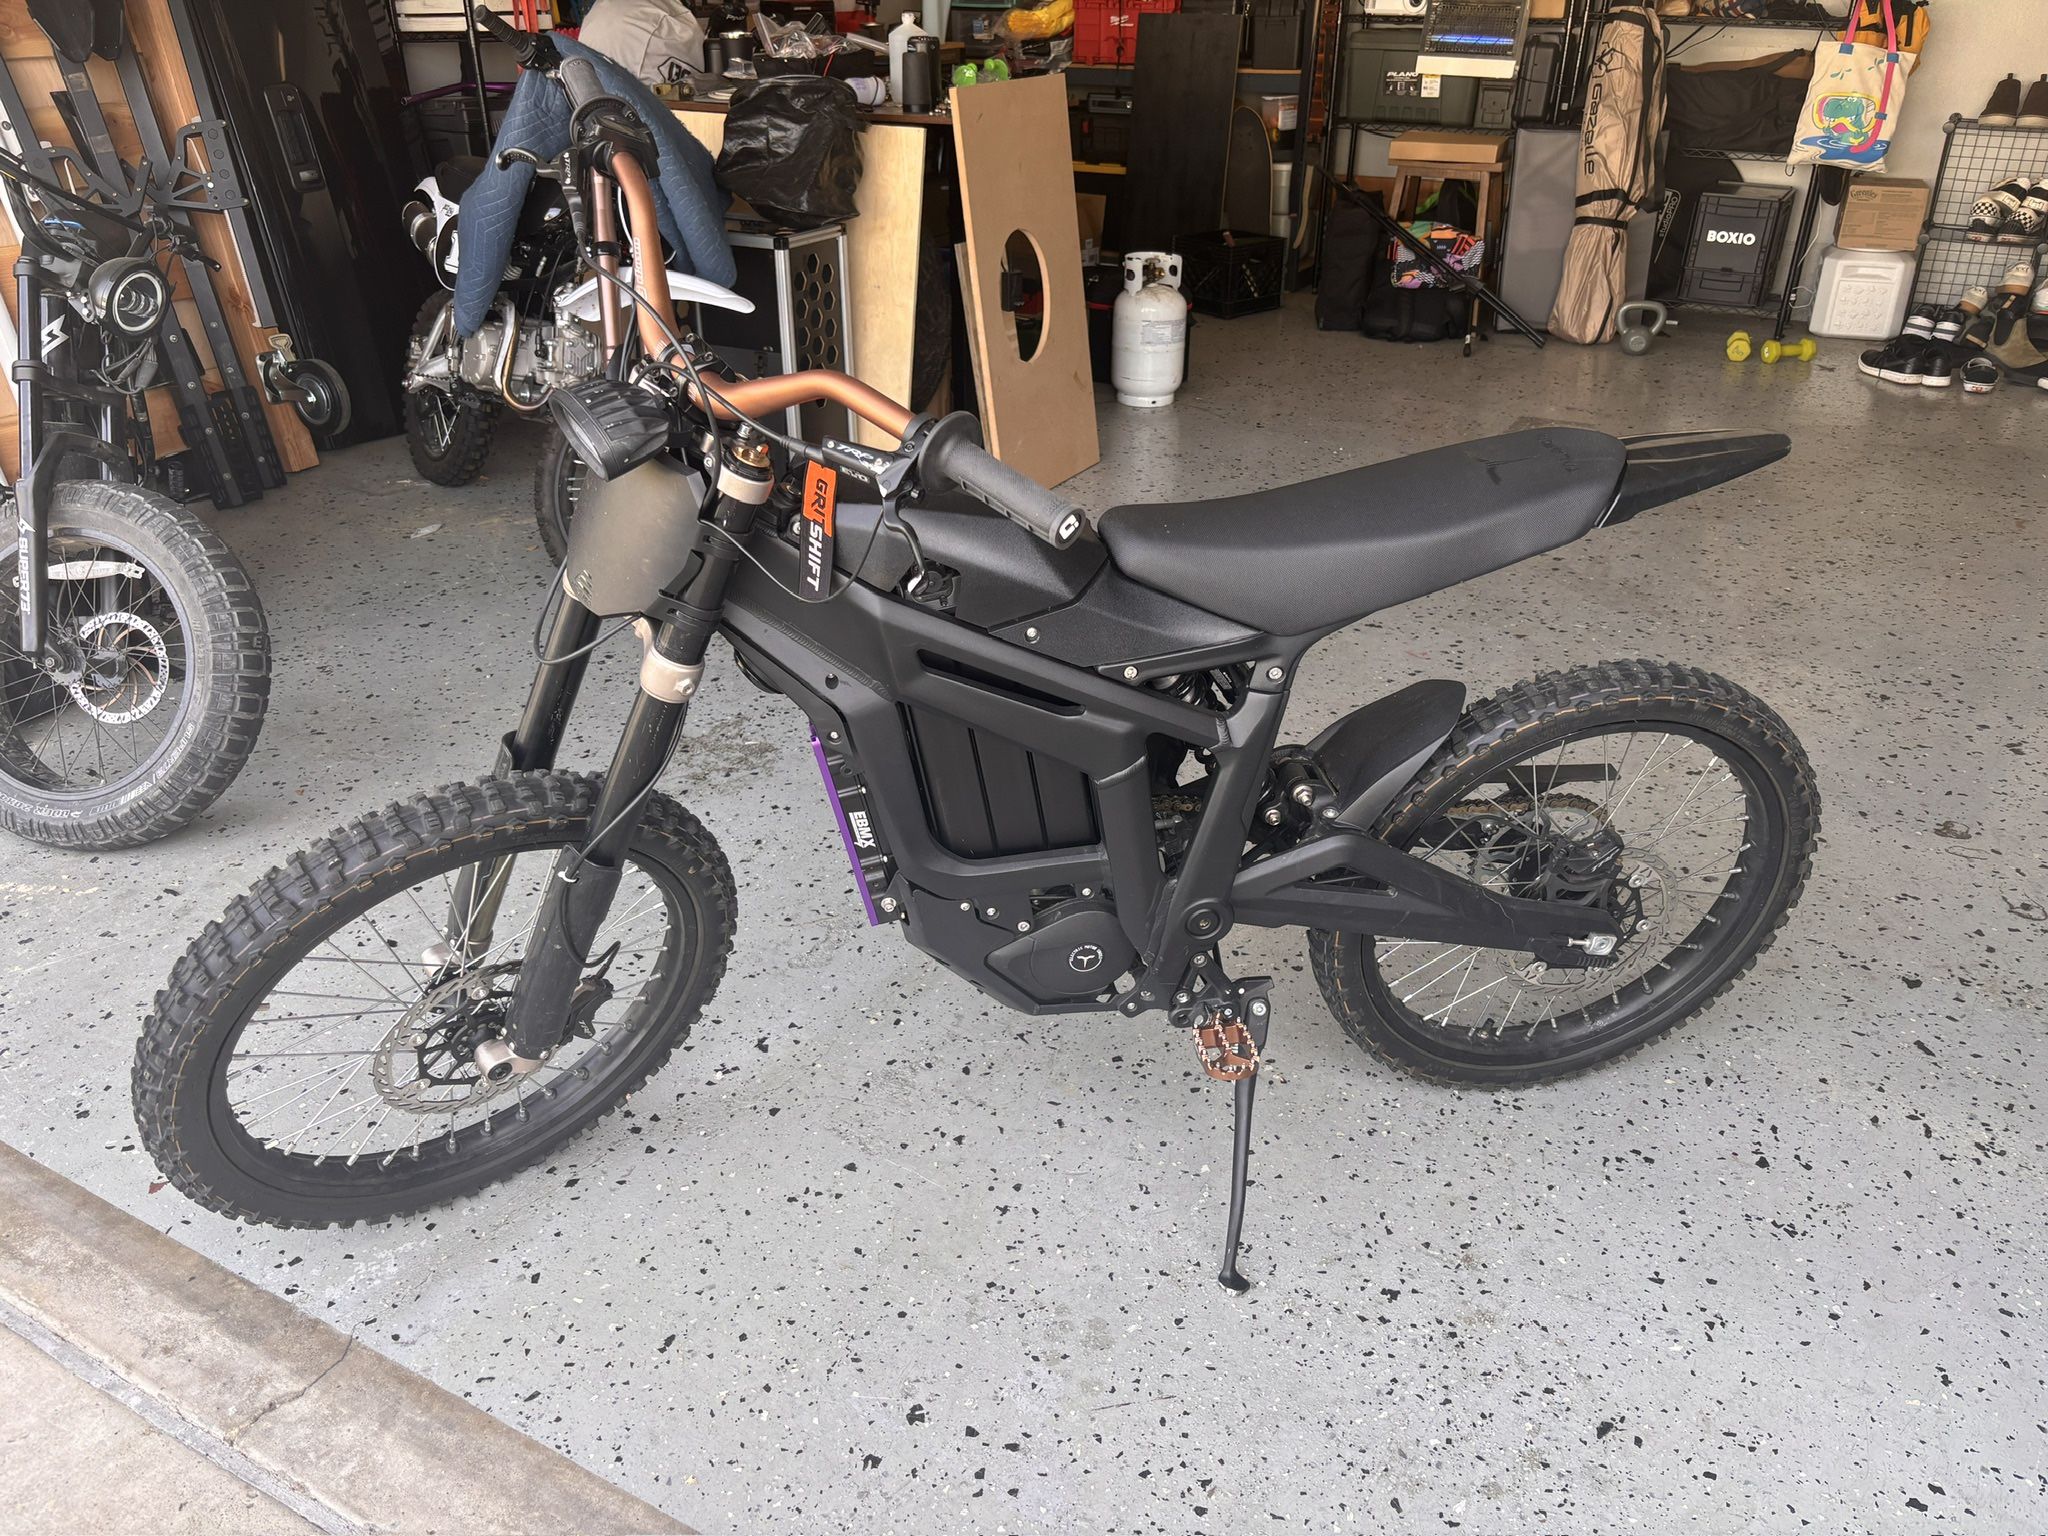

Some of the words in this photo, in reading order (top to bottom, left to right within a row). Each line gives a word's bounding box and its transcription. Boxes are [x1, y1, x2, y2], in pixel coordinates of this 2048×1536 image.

[1583, 83, 1602, 175] Gazelle
[1706, 229, 1756, 246] BOXIO
[19, 537, 31, 615] SUPER73
[849, 811, 876, 848] EBMX
